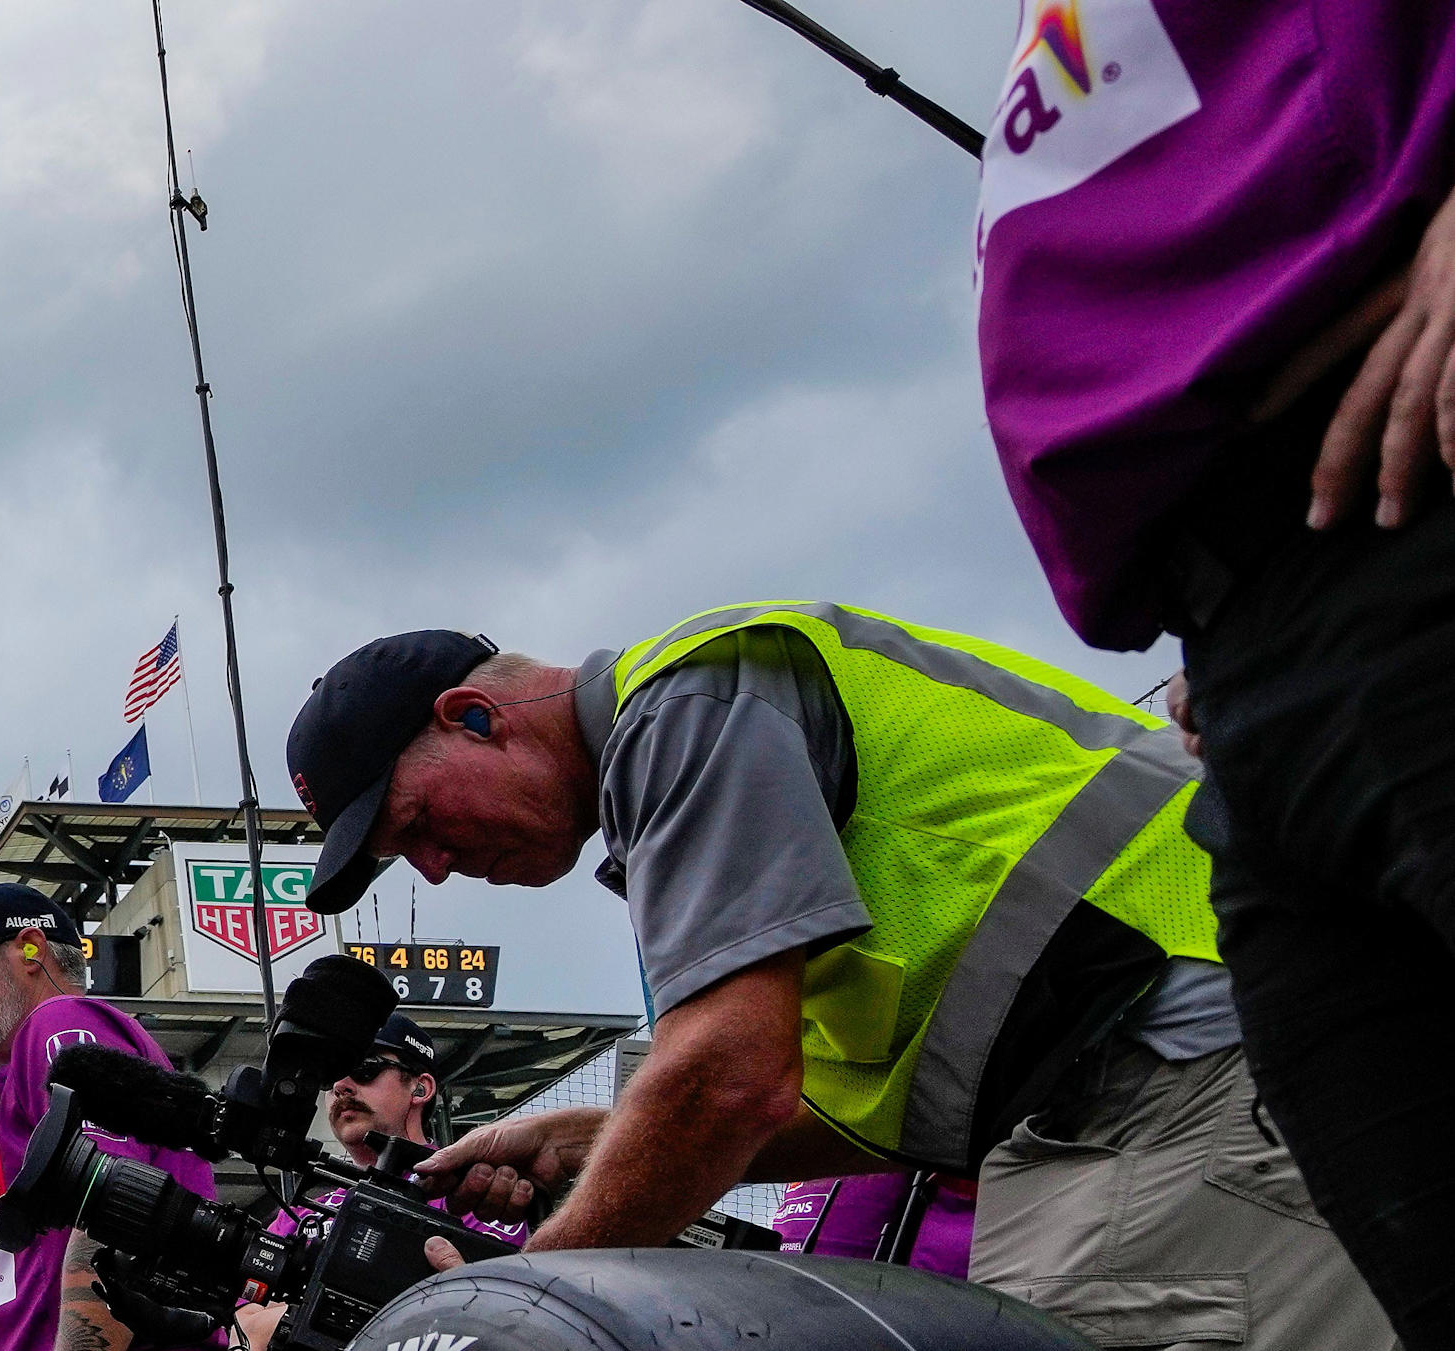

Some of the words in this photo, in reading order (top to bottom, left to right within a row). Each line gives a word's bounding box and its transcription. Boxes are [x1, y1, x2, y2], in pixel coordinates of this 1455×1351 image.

[200, 868, 307, 902] TAG
[5, 913, 58, 929] Allegra
[351, 946, 376, 967] 76
[390, 947, 408, 969] 4
[423, 949, 449, 970] 66
[460, 949, 486, 971] 24
[393, 975, 410, 999] 6
[428, 976, 446, 1000] 7
[465, 977, 484, 1001] 8
[403, 1034, 436, 1059] Allegra
[259, 1236, 285, 1250] Canon
